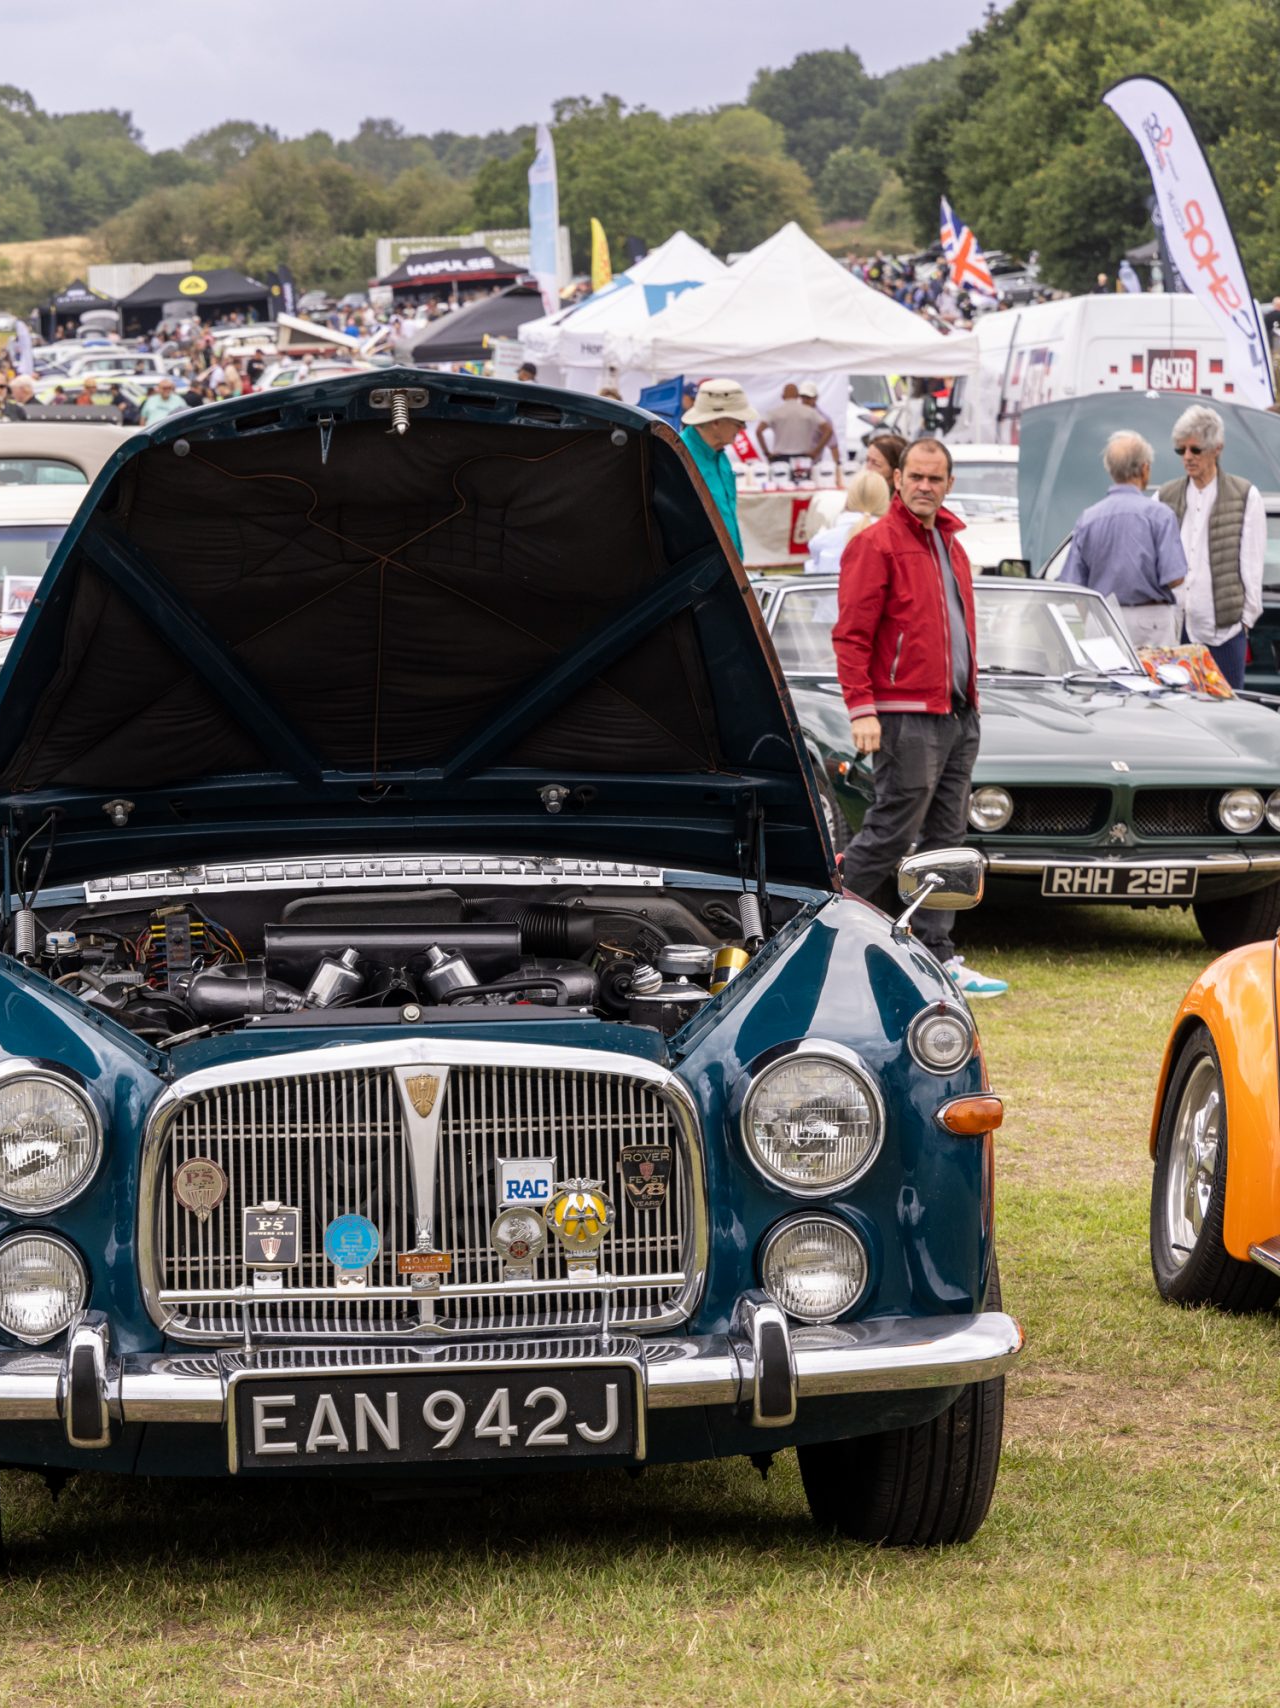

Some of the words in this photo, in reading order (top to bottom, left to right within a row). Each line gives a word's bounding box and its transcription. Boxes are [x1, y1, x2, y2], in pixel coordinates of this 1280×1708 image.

[406, 256, 495, 277] IMPULSE
[1151, 357, 1193, 375] AUTO
[1052, 868, 1114, 894] RHH
[1127, 869, 1188, 894] 29F
[623, 1152, 670, 1162] ROVER
[186, 1171, 214, 1184] P5
[506, 1179, 548, 1199] RAC
[626, 1183, 665, 1195] V8
[257, 1220, 284, 1231] P5
[405, 1256, 443, 1264] ROVER
[252, 1391, 400, 1456] EAN
[421, 1382, 619, 1450] 942J
